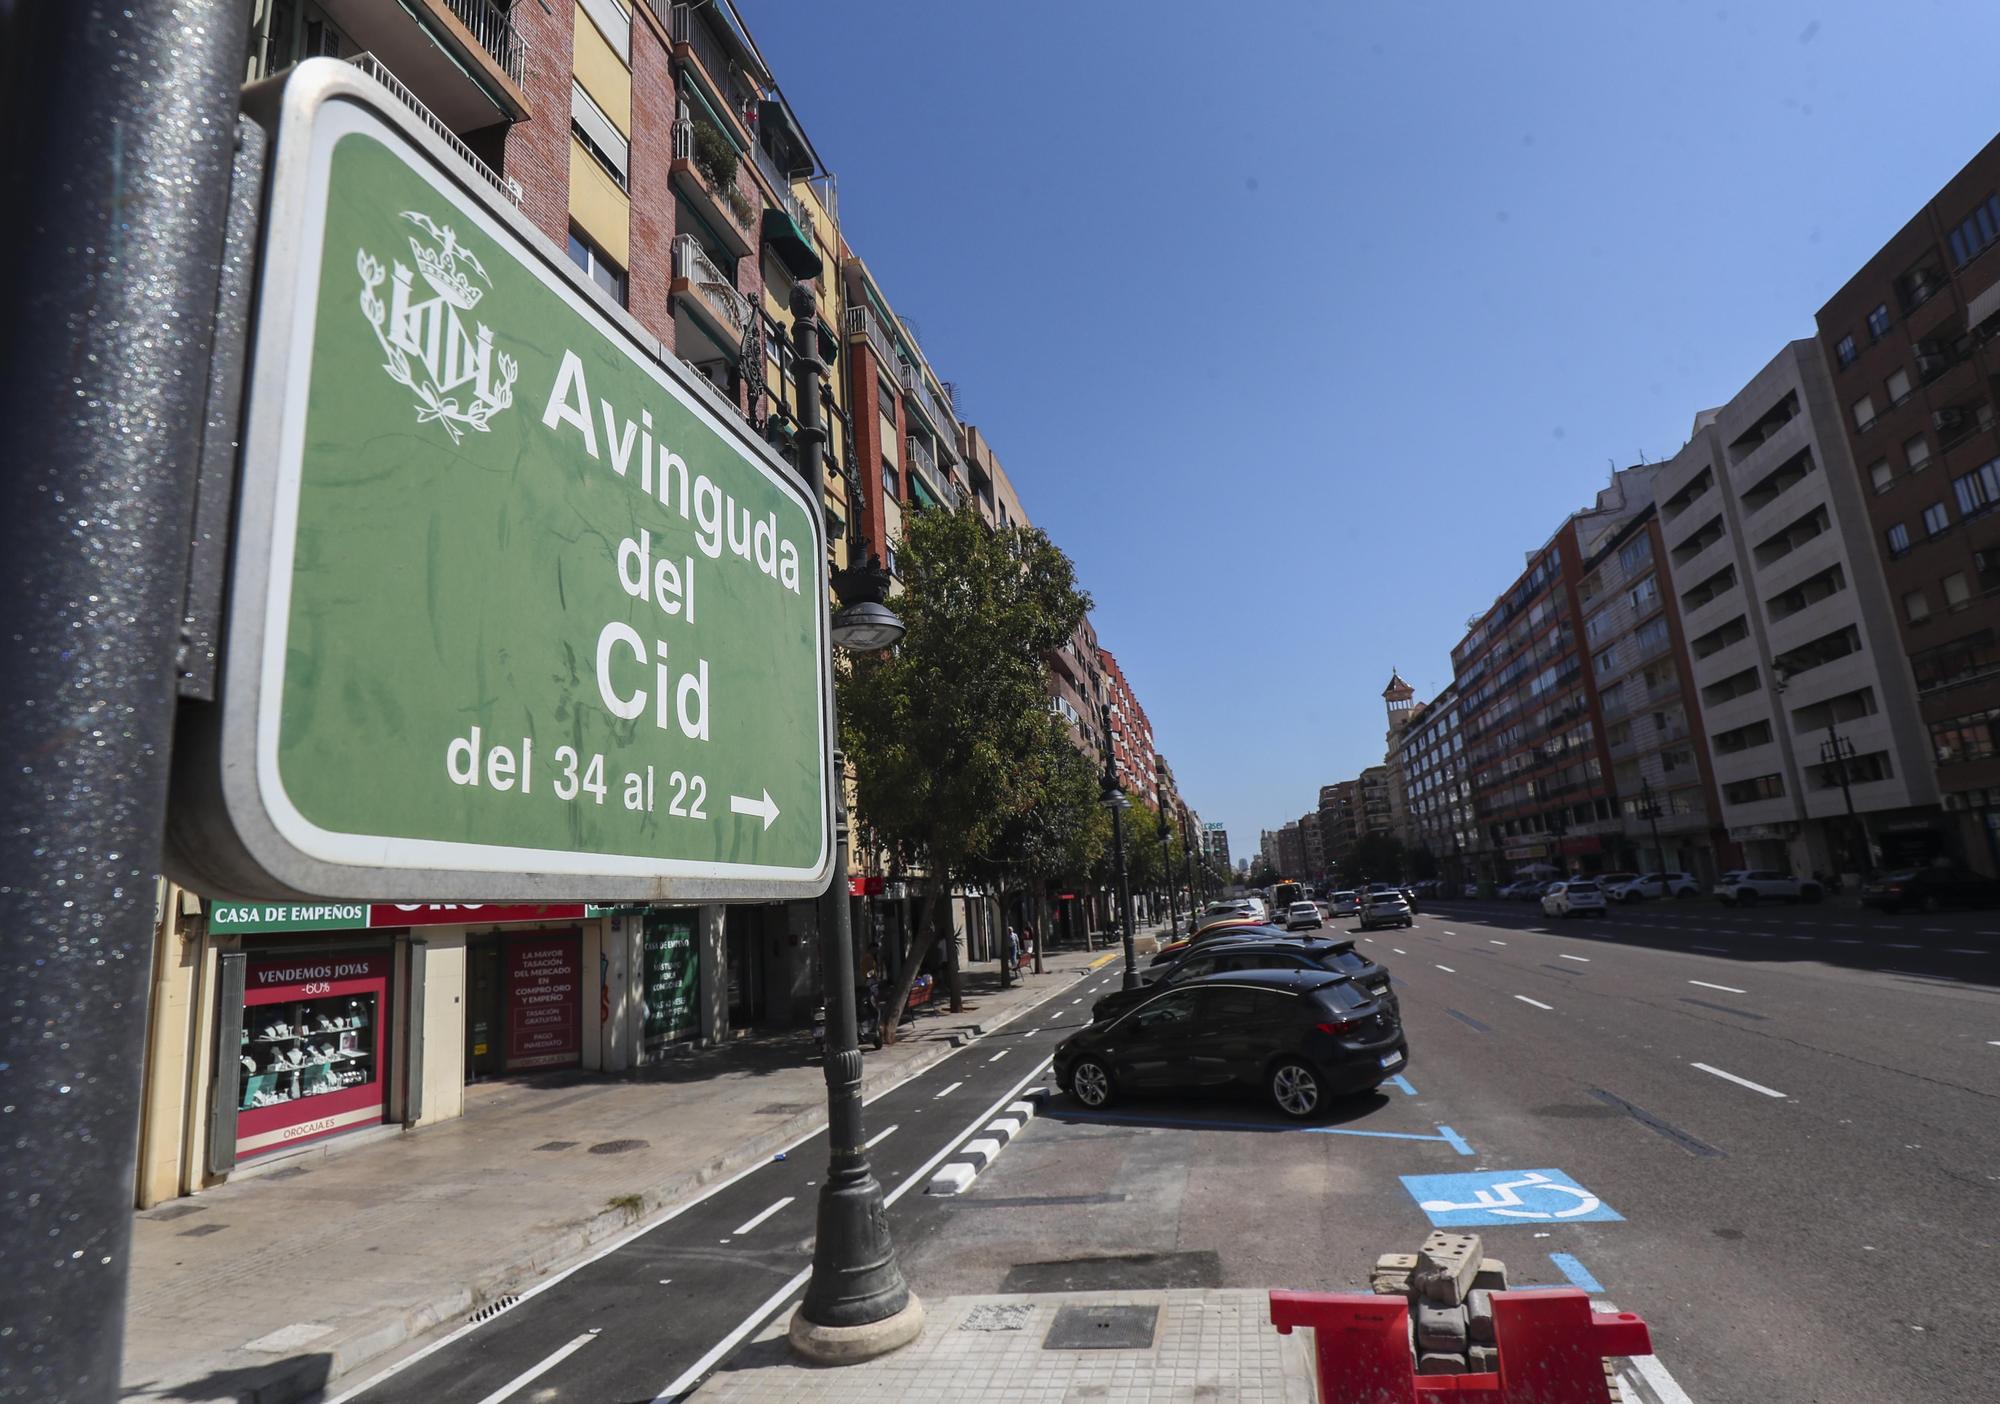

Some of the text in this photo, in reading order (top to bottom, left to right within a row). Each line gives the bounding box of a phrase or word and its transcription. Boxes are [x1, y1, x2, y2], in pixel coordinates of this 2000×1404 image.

[541, 348, 801, 596] Avinguda
[617, 527, 695, 625] del
[595, 620, 710, 742] Cid
[446, 725, 707, 821] del 34 al 22
[215, 904, 362, 923] CASA DE EMPEÑOS
[534, 950, 563, 958] MAYOR
[259, 963, 369, 983] VENDEMOS JOYAS
[514, 967, 571, 978] DEL MERCADO
[515, 984, 571, 995] COMPRO ORO
[283, 1118, 336, 1139] OROCAJA.ES
